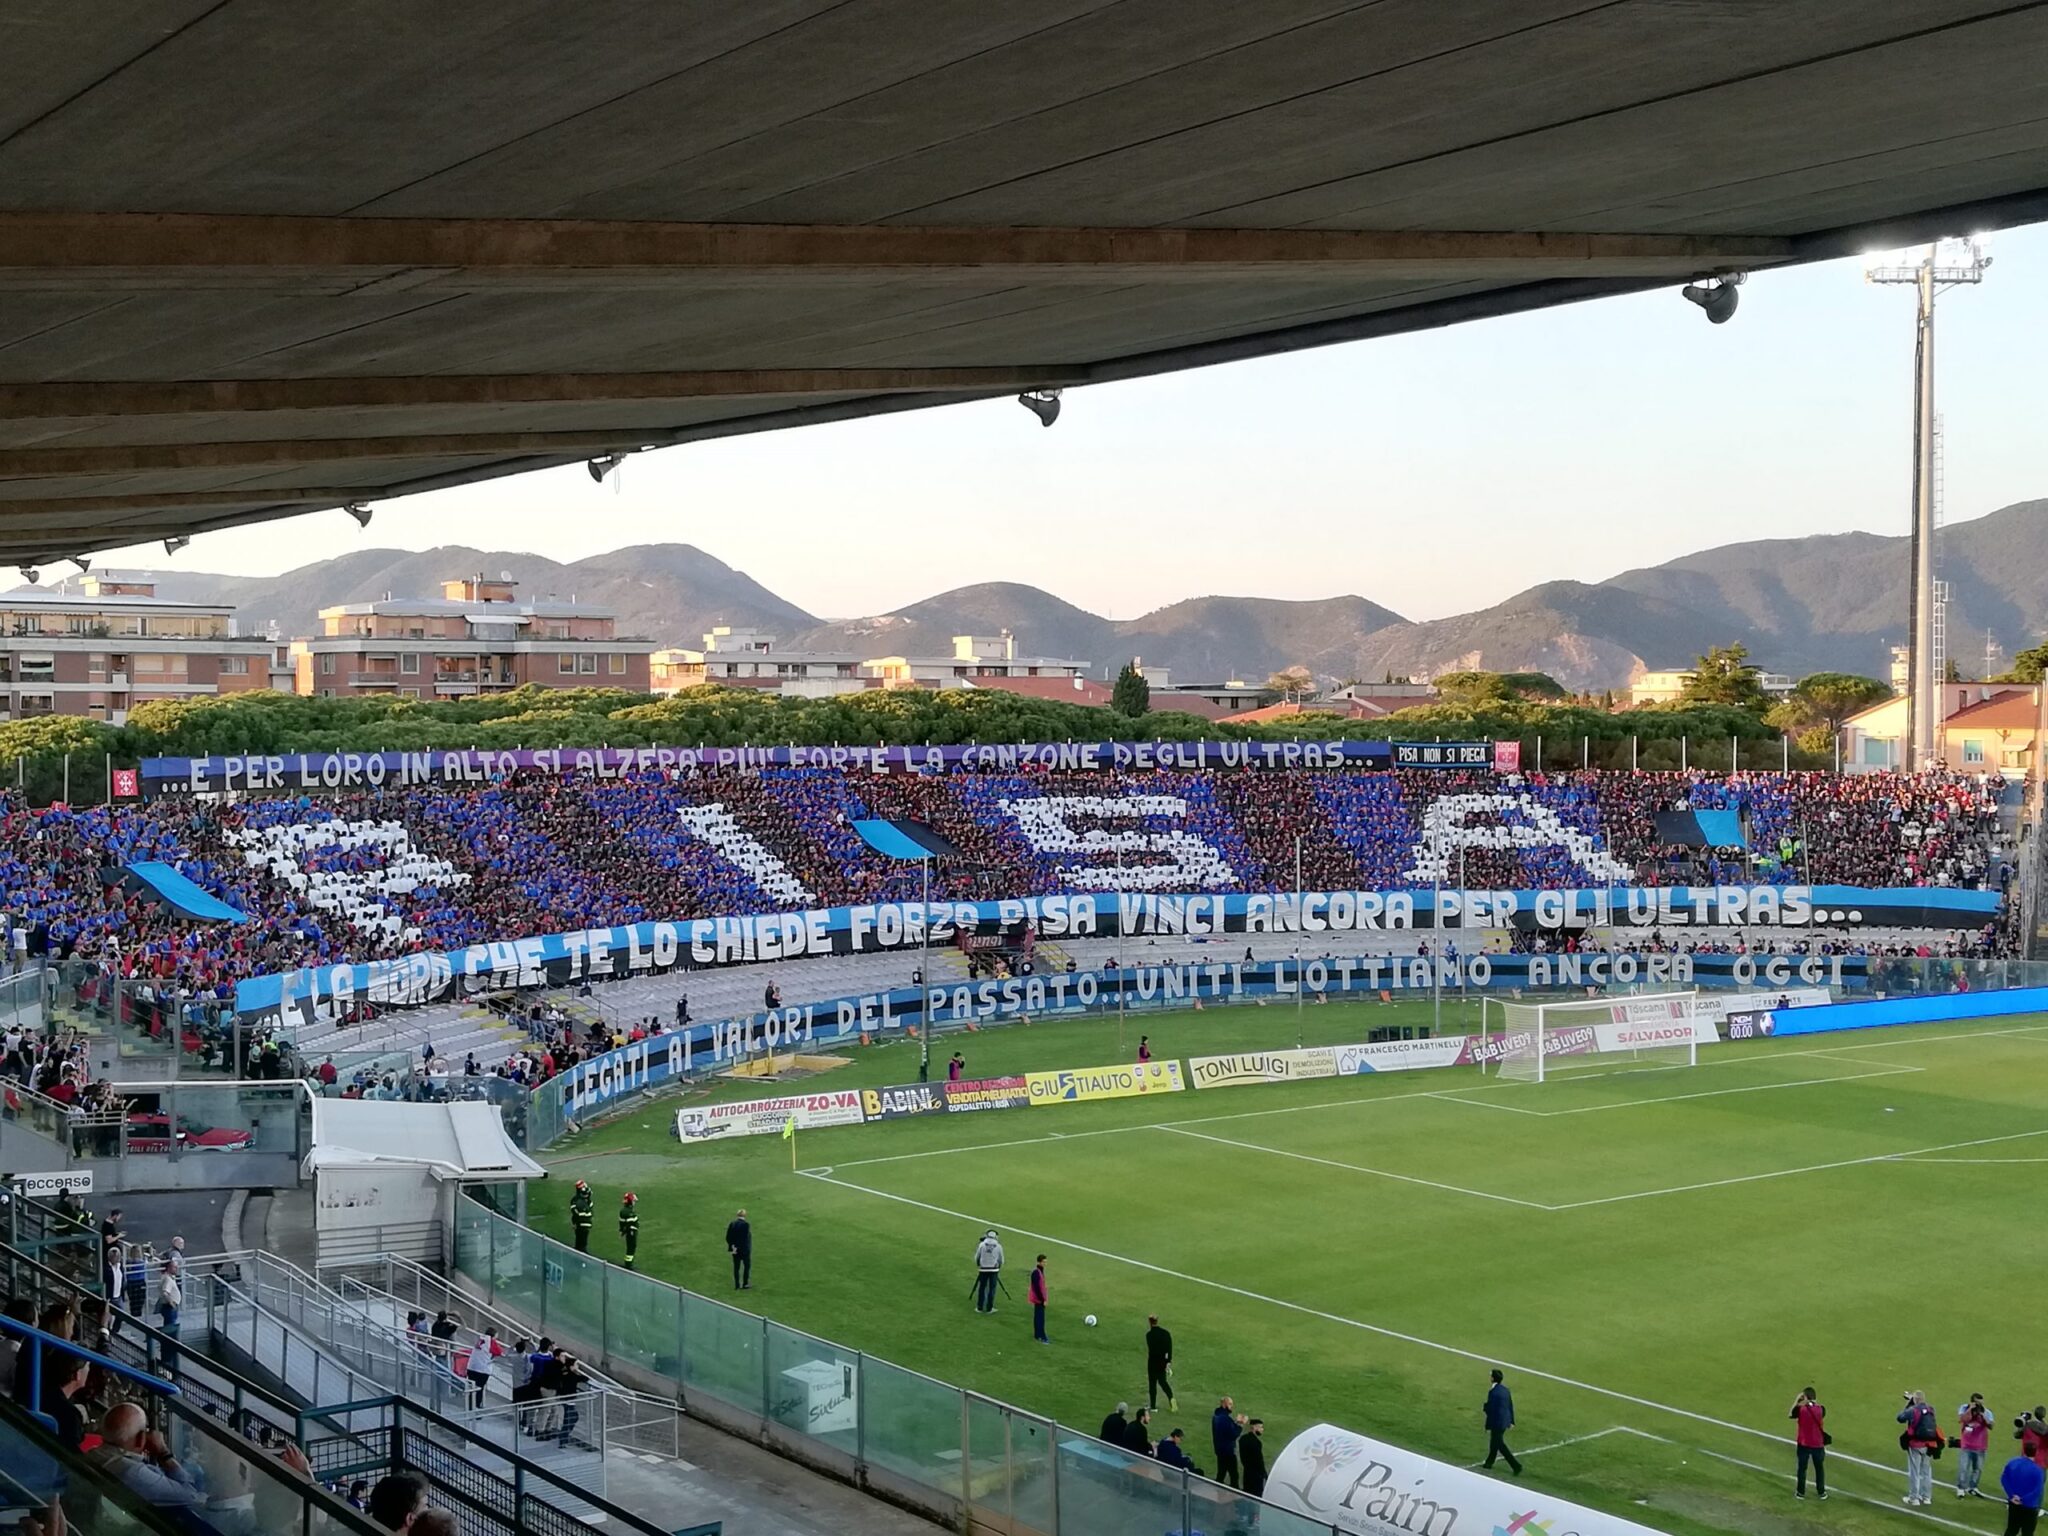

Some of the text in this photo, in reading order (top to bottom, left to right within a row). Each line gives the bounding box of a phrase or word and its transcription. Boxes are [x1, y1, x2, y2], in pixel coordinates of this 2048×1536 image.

[1399, 747, 1486, 763] PISA NON SI PIEGA
[225, 756, 285, 791] PER
[301, 753, 385, 788] LORO
[401, 752, 431, 785] IN
[444, 752, 518, 781] ALTO
[534, 749, 560, 775] SI
[789, 747, 890, 775] FORTE
[904, 747, 944, 773] LA
[962, 743, 1100, 771] CANZONE
[1113, 742, 1206, 769] DEGLI
[311, 963, 355, 1025] LA
[464, 936, 548, 993] CHE
[563, 928, 615, 980] TE
[625, 922, 678, 970] LO
[691, 910, 833, 964] CHIEDE
[850, 902, 979, 951] FORZA
[999, 894, 1097, 936] PISA
[1119, 892, 1226, 935] VINCI
[1246, 892, 1414, 933] ANCORA
[1438, 890, 1518, 929] PER
[1535, 889, 1612, 929] GLI
[1627, 885, 1863, 928] ULTRAS...
[1628, 1002, 1666, 1015] Toscana
[572, 1042, 649, 1111] LEGATI
[668, 1030, 692, 1075] AI
[711, 1006, 814, 1061] VALORI
[838, 993, 901, 1036] DEL
[1275, 956, 1492, 993] LOTTIAMO
[1528, 955, 1694, 987] ANCORA
[1733, 955, 1843, 986] OGGI
[1359, 1040, 1462, 1056] FRANCESCO MARTINELLI
[1194, 1057, 1289, 1082] TONI LUIGI
[944, 1082, 981, 1094] CENTRO
[946, 1091, 981, 1105] VENDITA
[709, 1097, 806, 1119] AUTOCARROZZERIA
[807, 1093, 859, 1112] ZO-VA
[862, 1088, 930, 1115] BABINI
[949, 1101, 992, 1112] OSPEDALETTO
